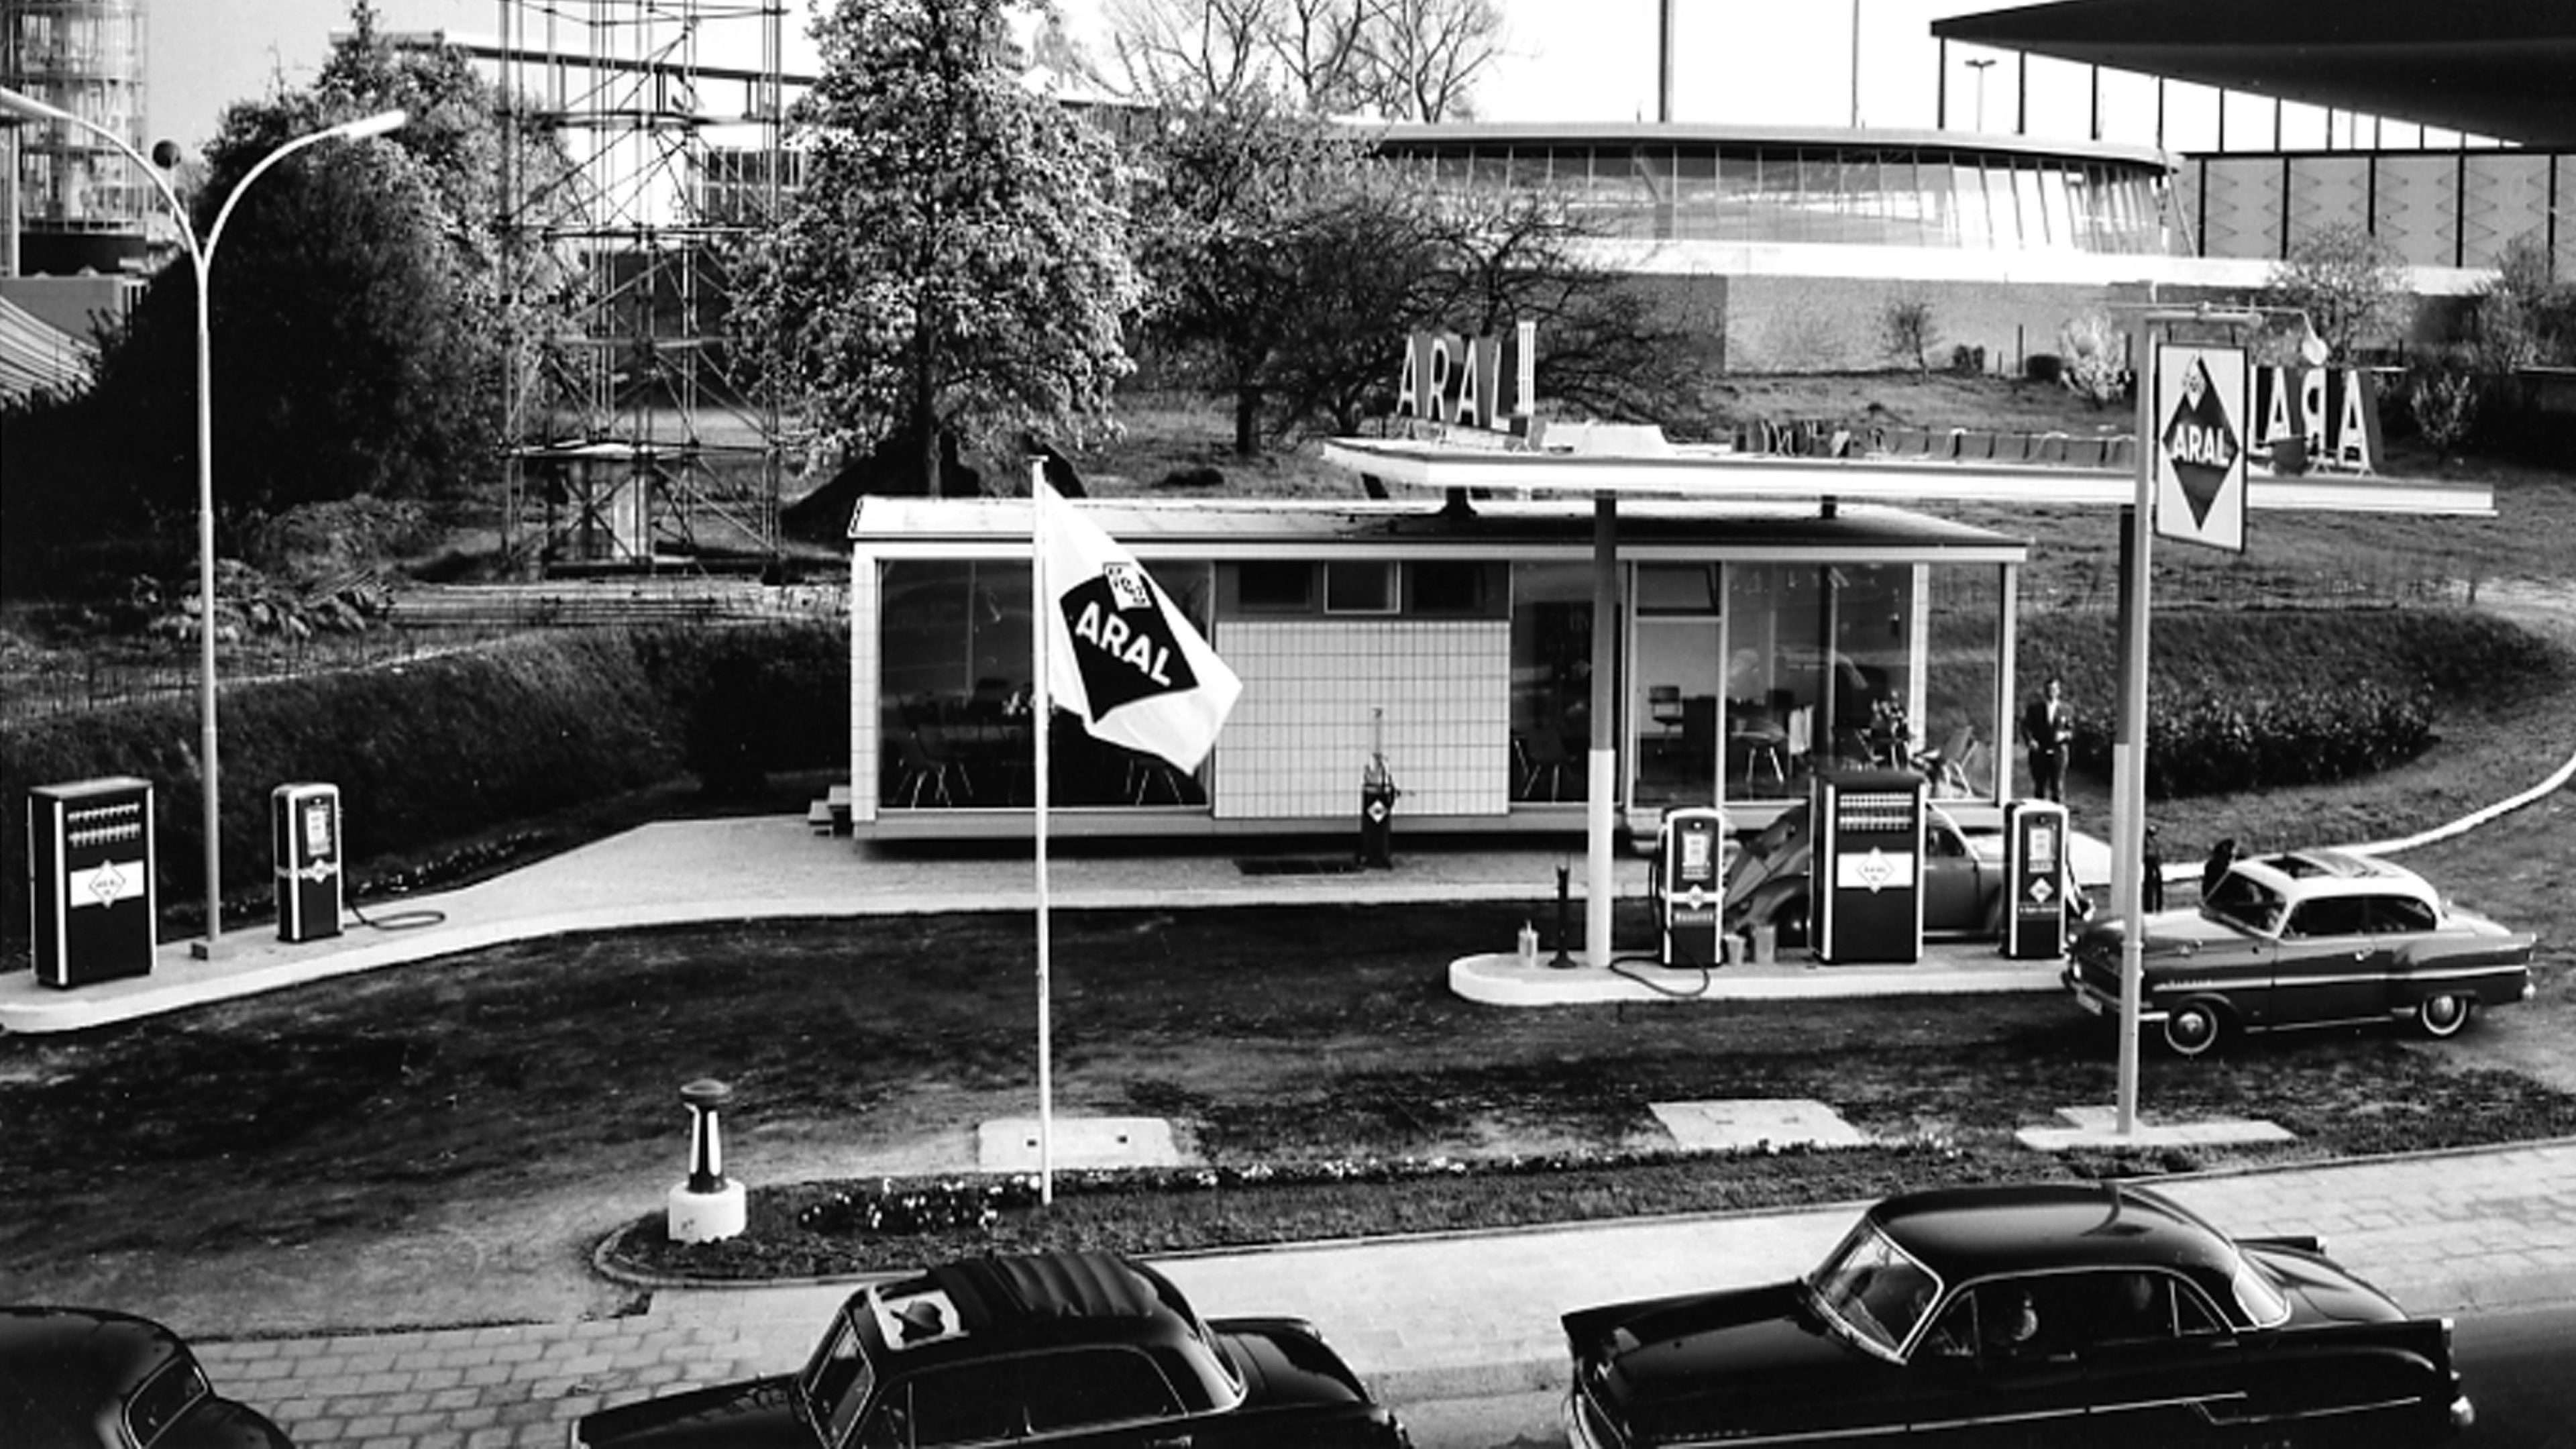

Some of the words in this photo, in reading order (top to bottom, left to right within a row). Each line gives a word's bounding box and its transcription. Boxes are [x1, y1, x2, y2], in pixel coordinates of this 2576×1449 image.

[1397, 335, 1511, 429] ARAL
[2172, 424, 2229, 468] ARAL
[1075, 601, 1171, 687] ARAL
